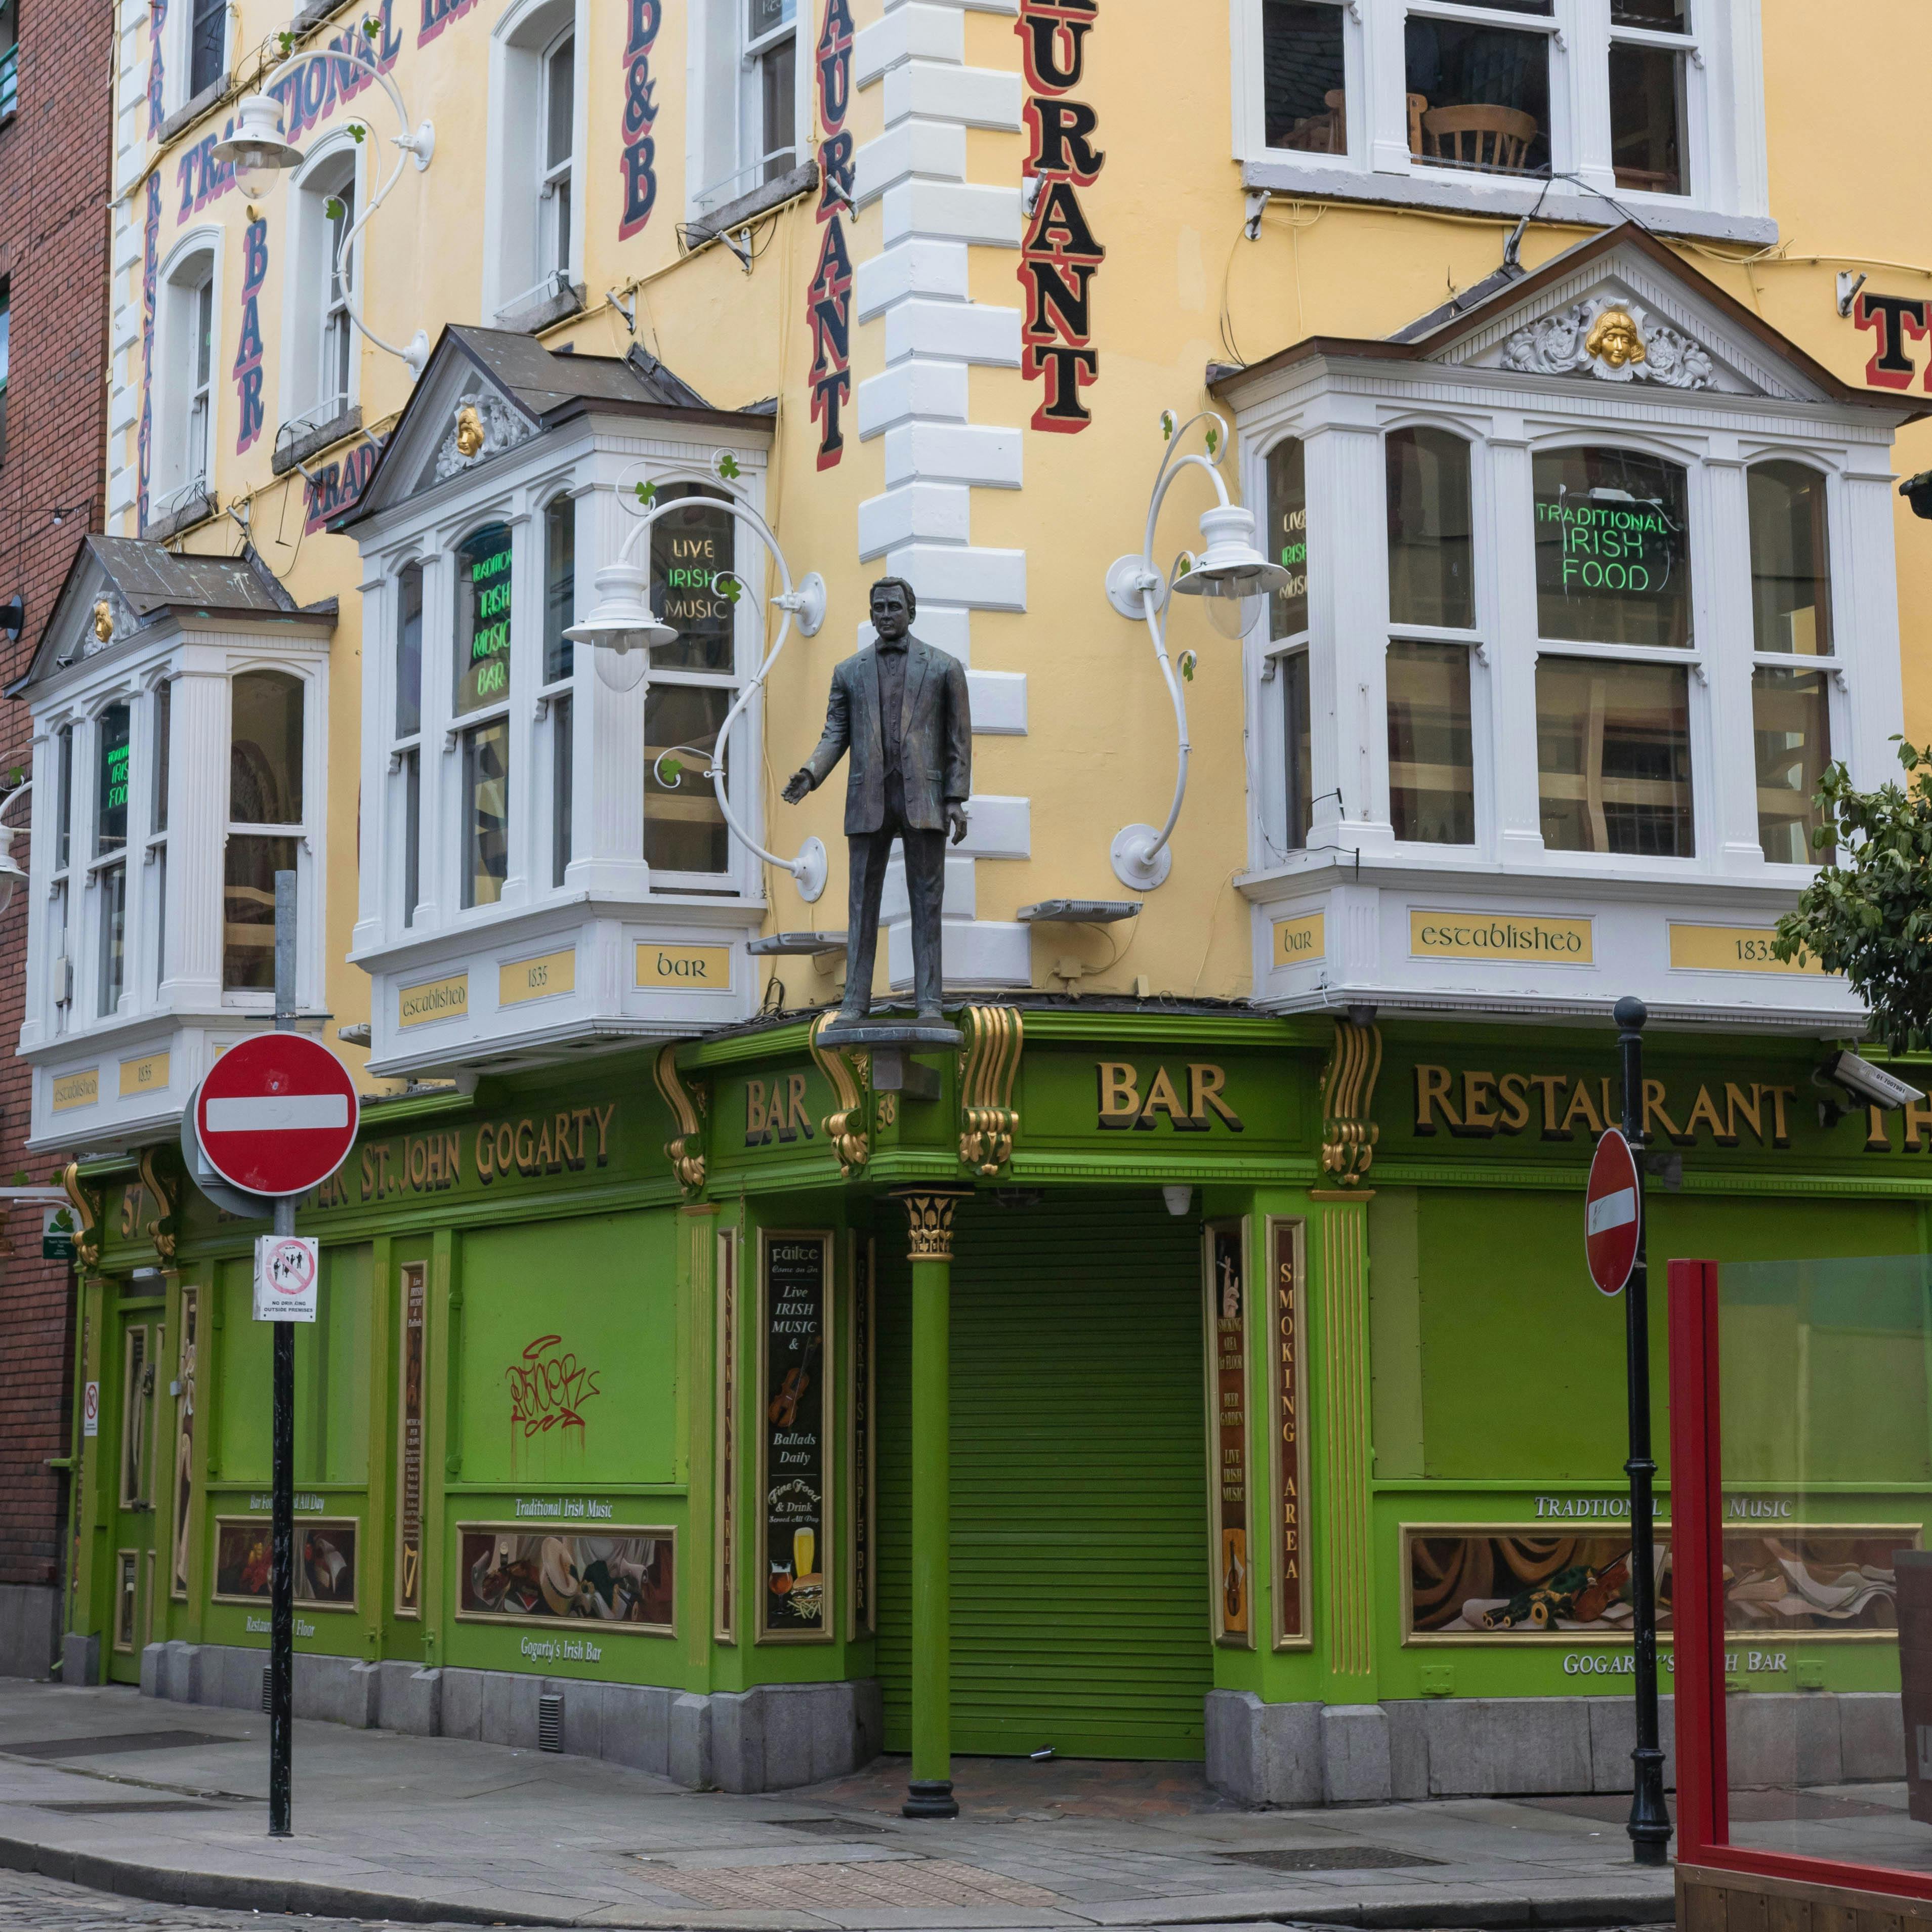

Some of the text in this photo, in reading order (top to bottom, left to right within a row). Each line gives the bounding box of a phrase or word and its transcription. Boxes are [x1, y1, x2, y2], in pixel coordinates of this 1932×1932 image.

[1014, 0, 1106, 434] URANT
[232, 218, 268, 455] BAR
[1535, 503, 1667, 534] TRADITIONAL
[673, 539, 714, 558] LIVE
[1564, 527, 1643, 559] IRISH
[669, 568, 718, 587] IRISH
[1563, 559, 1649, 591] FOOD
[481, 580, 511, 618] IRISH
[664, 599, 728, 619] MUSIC
[477, 661, 504, 696] BAR
[1420, 923, 1582, 953] established
[403, 964, 548, 1017] established 1835
[1095, 1062, 1244, 1132] BAR
[1413, 1064, 1798, 1149] RESTAURANT
[746, 1074, 814, 1147] BAR
[399, 1130, 460, 1195] JOHN
[476, 1104, 615, 1185] GOGARTY
[783, 1286, 808, 1298] Live
[775, 1303, 814, 1316] IRISH
[771, 1321, 817, 1333] MUSIC
[1217, 1317, 1242, 1332] SMOKING
[789, 1338, 798, 1350] &
[1223, 1336, 1238, 1351] AREA
[1224, 1393, 1239, 1407] BEER
[1220, 1412, 1243, 1426] GARDEN
[1279, 1263, 1298, 1579] SMOKING AREA
[773, 1433, 816, 1446] Ballads
[779, 1451, 811, 1465] Daily
[1224, 1449, 1240, 1464] LIVE
[1224, 1468, 1242, 1483] IRISH
[768, 1479, 821, 1505] Fine Food
[1223, 1487, 1244, 1502] MUSIC
[515, 1498, 613, 1518] Traditional Irish Music
[775, 1501, 813, 1513] & Drink
[521, 1636, 602, 1663] Gogarty's Irish Bar
[1748, 1652, 1788, 1671] BAR
